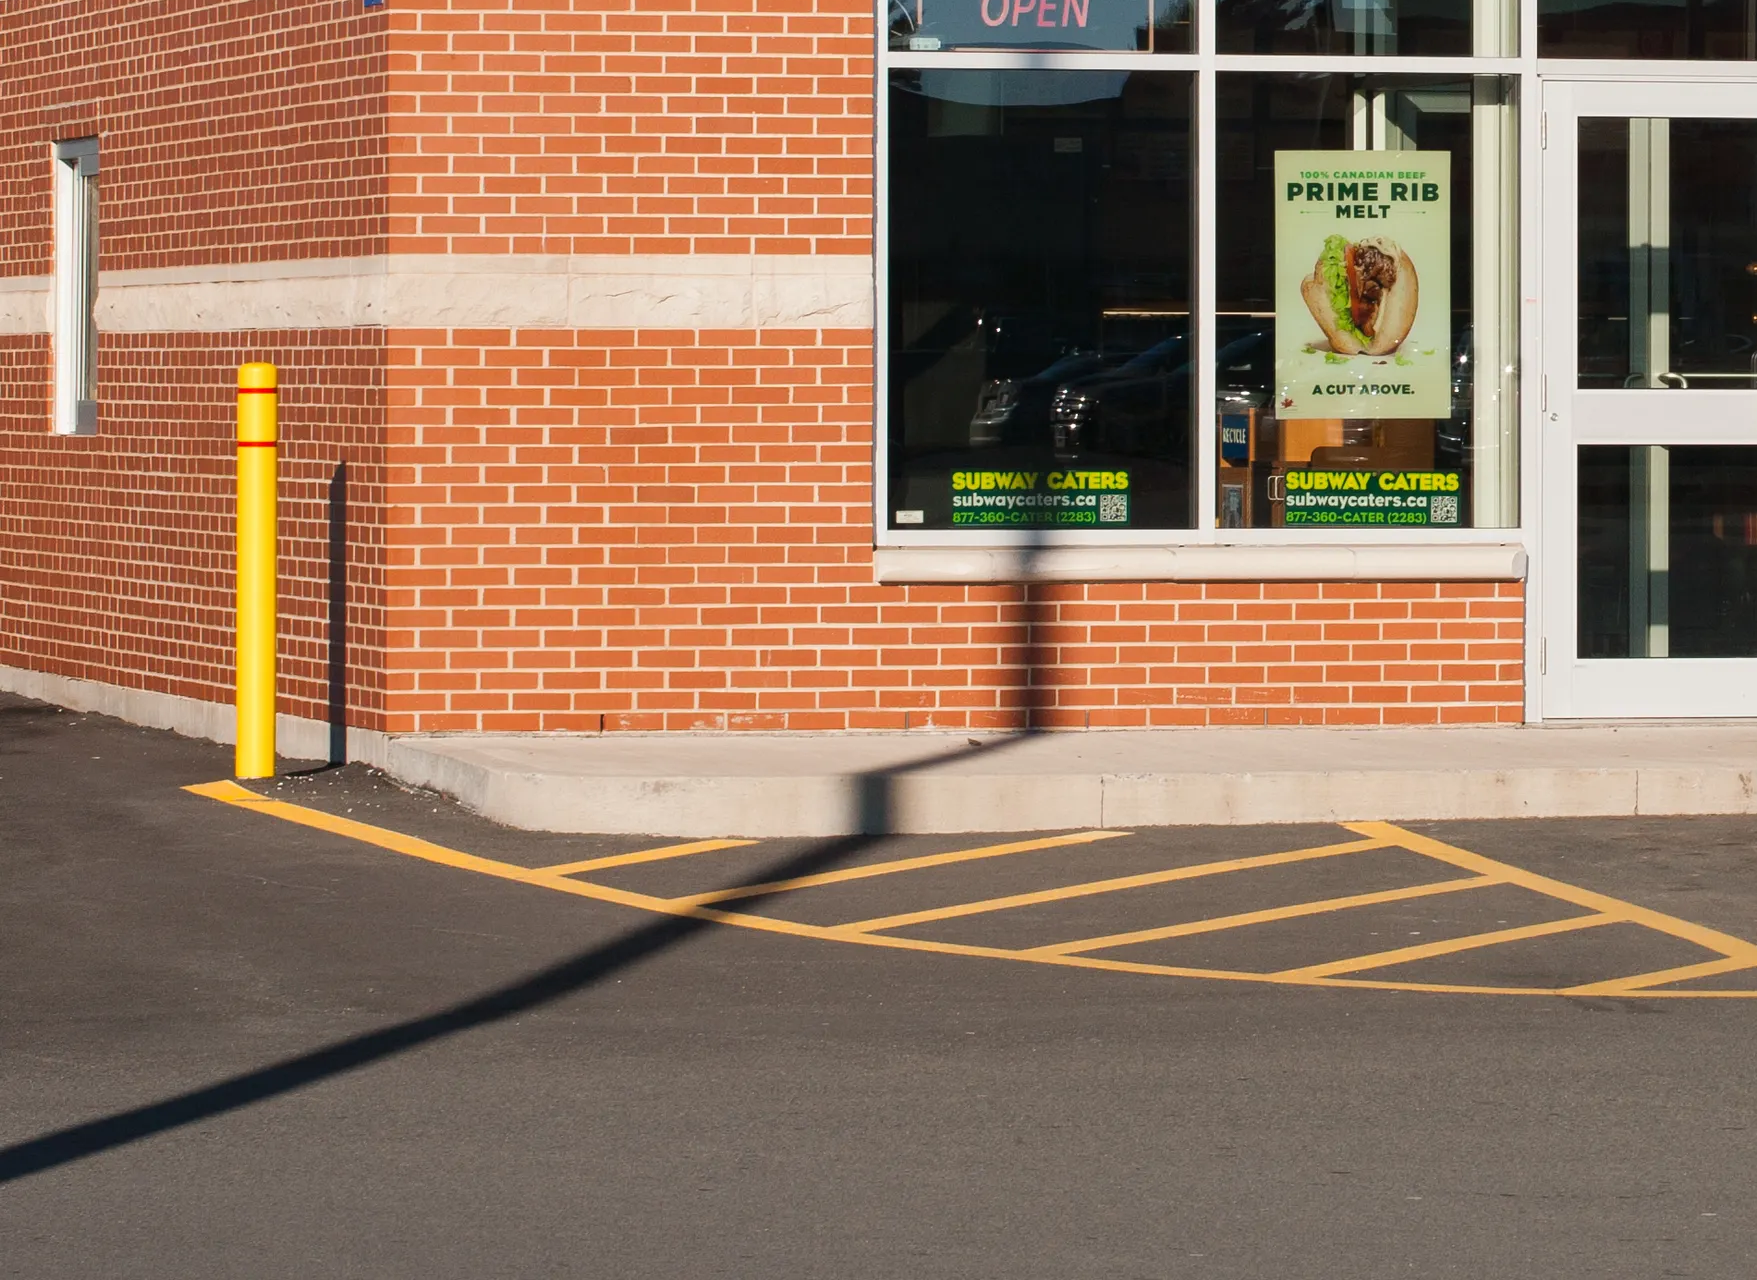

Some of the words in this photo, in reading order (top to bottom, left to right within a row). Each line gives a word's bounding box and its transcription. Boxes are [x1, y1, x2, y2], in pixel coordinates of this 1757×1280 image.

[1300, 171, 1329, 180] 100%
[1333, 171, 1394, 180] CANADIAN
[1398, 171, 1427, 180] BEEF
[1287, 182, 1379, 202] PRIME
[1391, 182, 1440, 202] RIB
[1336, 204, 1392, 219] MELT
[1312, 384, 1323, 395] A
[1326, 384, 1355, 396] CUT
[1360, 384, 1416, 396] ABOVE.
[1223, 427, 1247, 444] RECYCLE
[952, 471, 1039, 491] SUBWAY
[1047, 471, 1129, 491] CATERS
[1285, 471, 1371, 491] SUBWAY
[1378, 472, 1460, 491] CATERS
[953, 492, 1096, 510] subwaycaters.ca
[1286, 492, 1427, 509] subwaycaters.ca
[1056, 511, 1096, 524] (2283)
[1286, 511, 1385, 524] 877-360-CATER
[1387, 511, 1427, 525] (2283)
